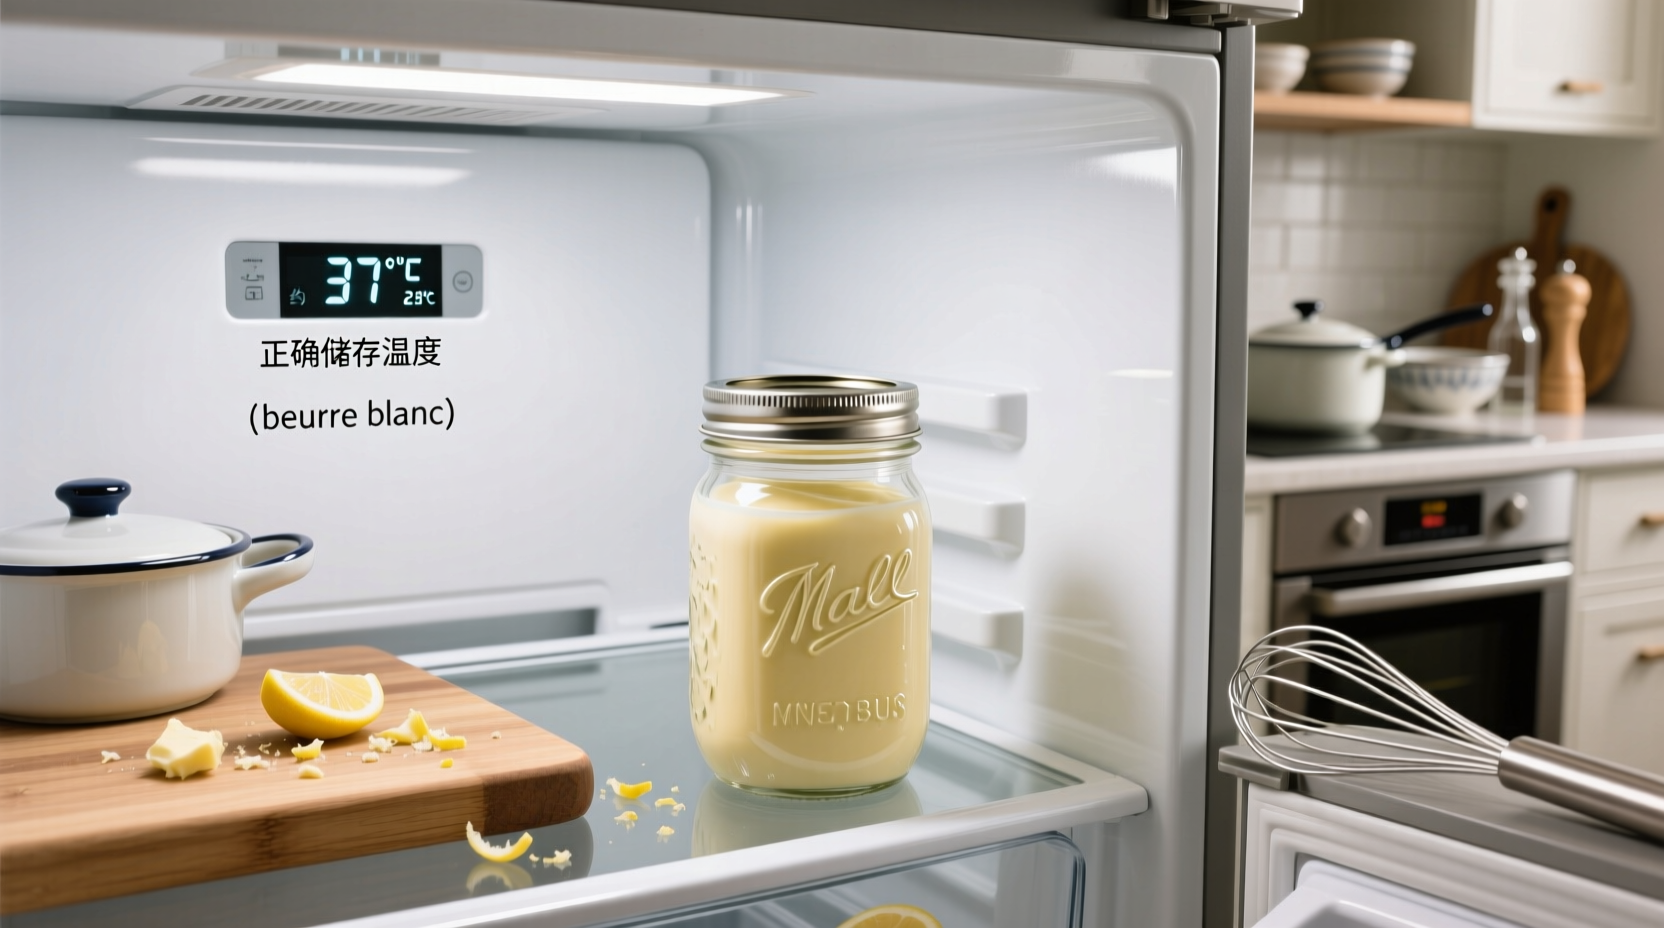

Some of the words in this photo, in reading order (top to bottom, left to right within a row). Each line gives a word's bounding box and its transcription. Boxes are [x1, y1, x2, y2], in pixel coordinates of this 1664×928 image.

[260, 335, 442, 369] 正确储存温度
[249, 402, 358, 436] (beurre
[367, 396, 455, 431] blanc)
[759, 548, 919, 657] Mall
